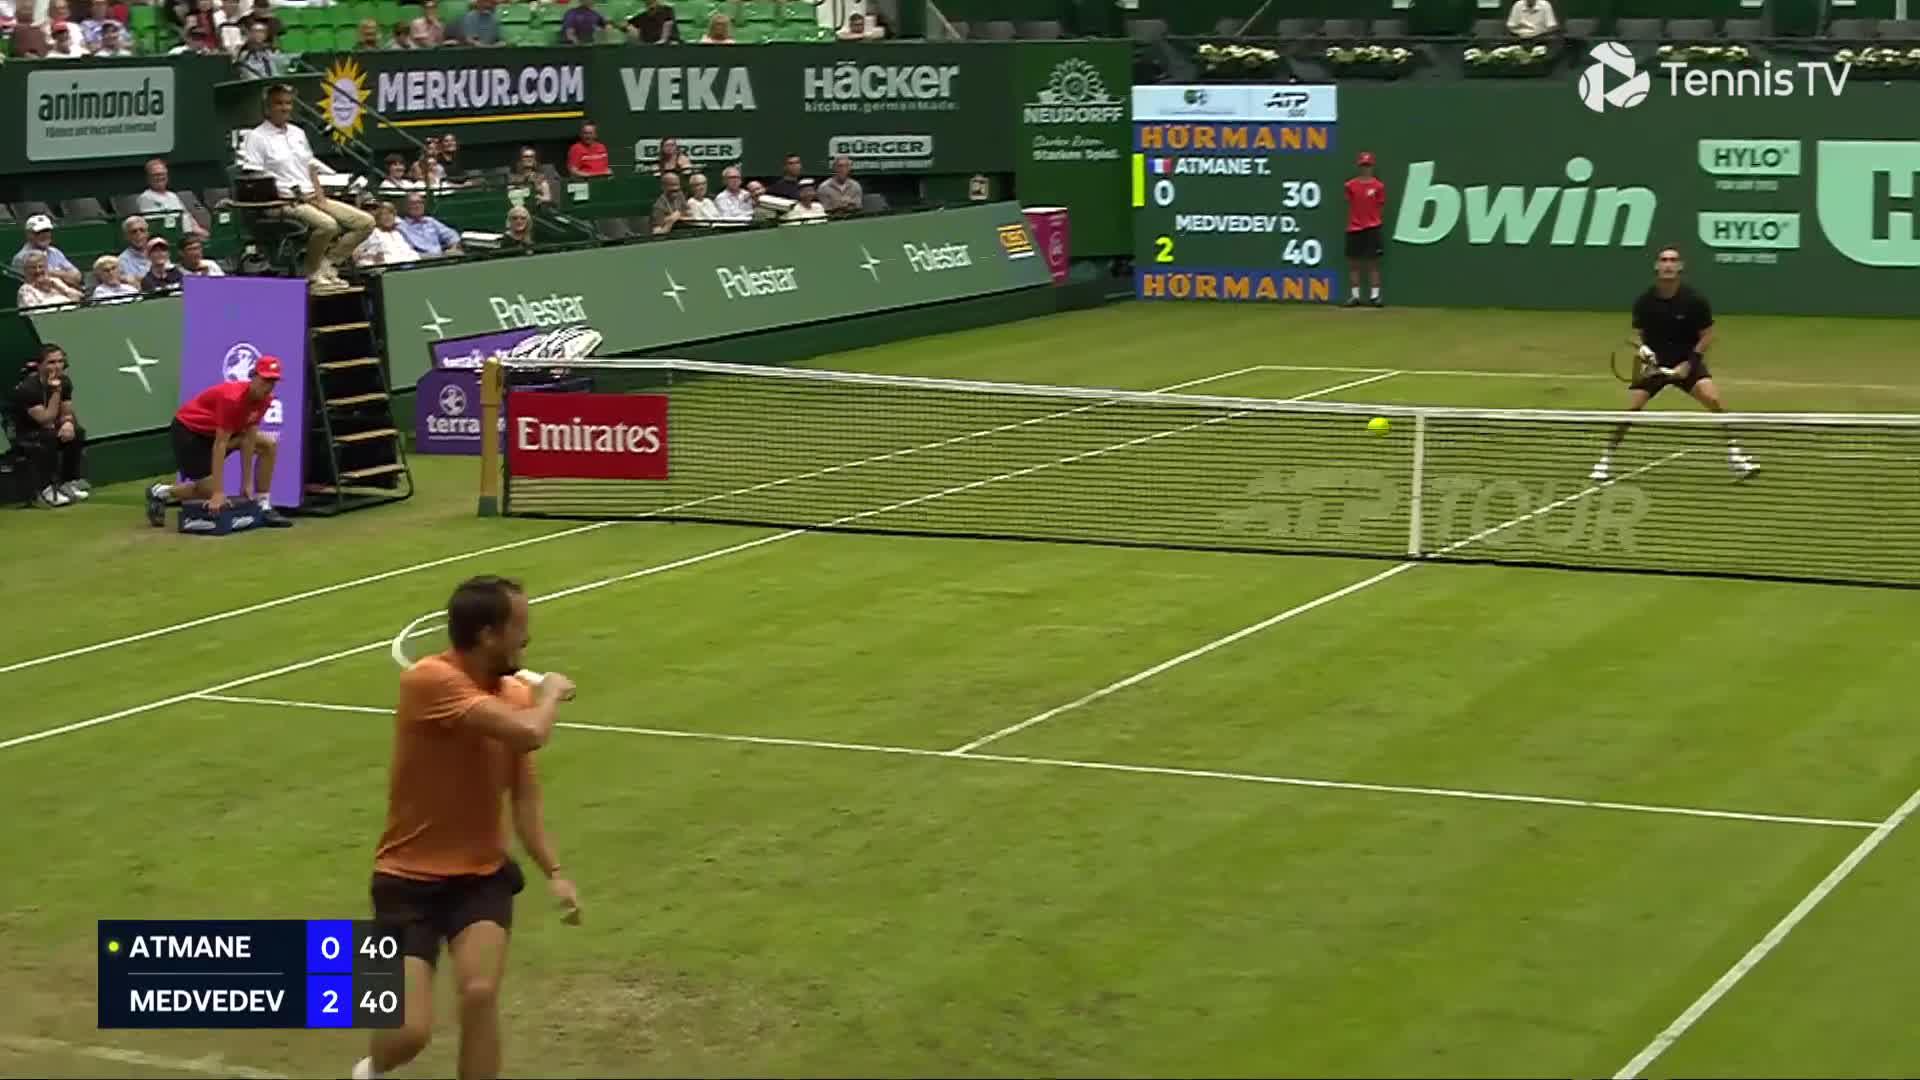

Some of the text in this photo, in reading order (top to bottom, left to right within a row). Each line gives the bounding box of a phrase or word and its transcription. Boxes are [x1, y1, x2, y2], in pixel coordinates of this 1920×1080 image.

[378, 65, 585, 112] MERKUR.COM
[619, 66, 757, 111] VEKA
[804, 60, 960, 100] Häcker
[38, 77, 164, 121] animonda
[1264, 91, 1310, 109] ATP
[1023, 106, 1124, 123] NEUDORFF
[644, 143, 734, 158] BRGER
[837, 139, 925, 155] BÜRGER
[1140, 123, 1329, 150] HÖRMANN
[1174, 157, 1271, 175] ATMANE T.
[1154, 179, 1321, 208] 0 30
[1392, 156, 1657, 247] bwin
[1175, 214, 1300, 233] MEDVEDEV D.
[903, 241, 973, 273] Polestar
[1155, 236, 1323, 265] 2 40
[716, 265, 799, 299] Polestar
[1143, 272, 1330, 301] HÖRMANN
[489, 294, 587, 330] Polestar
[426, 415, 480, 434] terra
[517, 417, 661, 454] Emirates
[1424, 477, 1652, 553] TOUR
